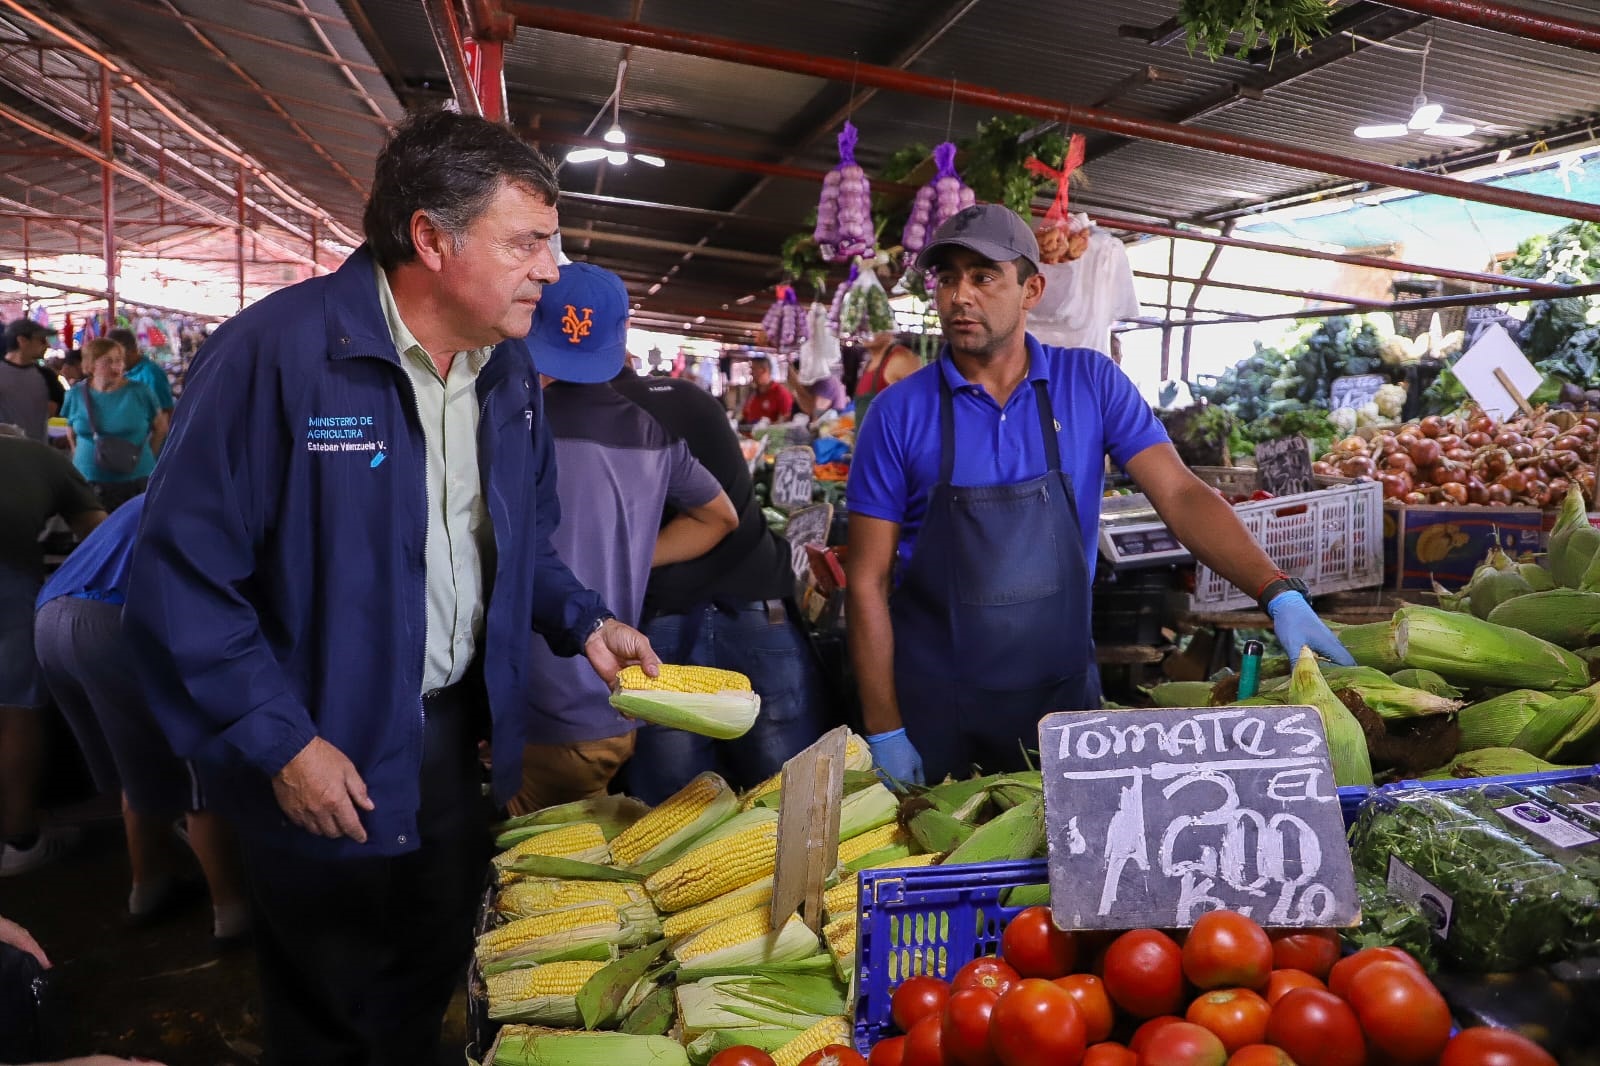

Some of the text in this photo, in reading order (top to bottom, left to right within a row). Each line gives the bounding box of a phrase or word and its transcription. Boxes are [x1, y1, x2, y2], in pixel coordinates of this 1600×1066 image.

[308, 417, 373, 426] MINISTERIO DE
[307, 429, 363, 439] AGRICULTURA
[307, 442, 339, 451] Esteban
